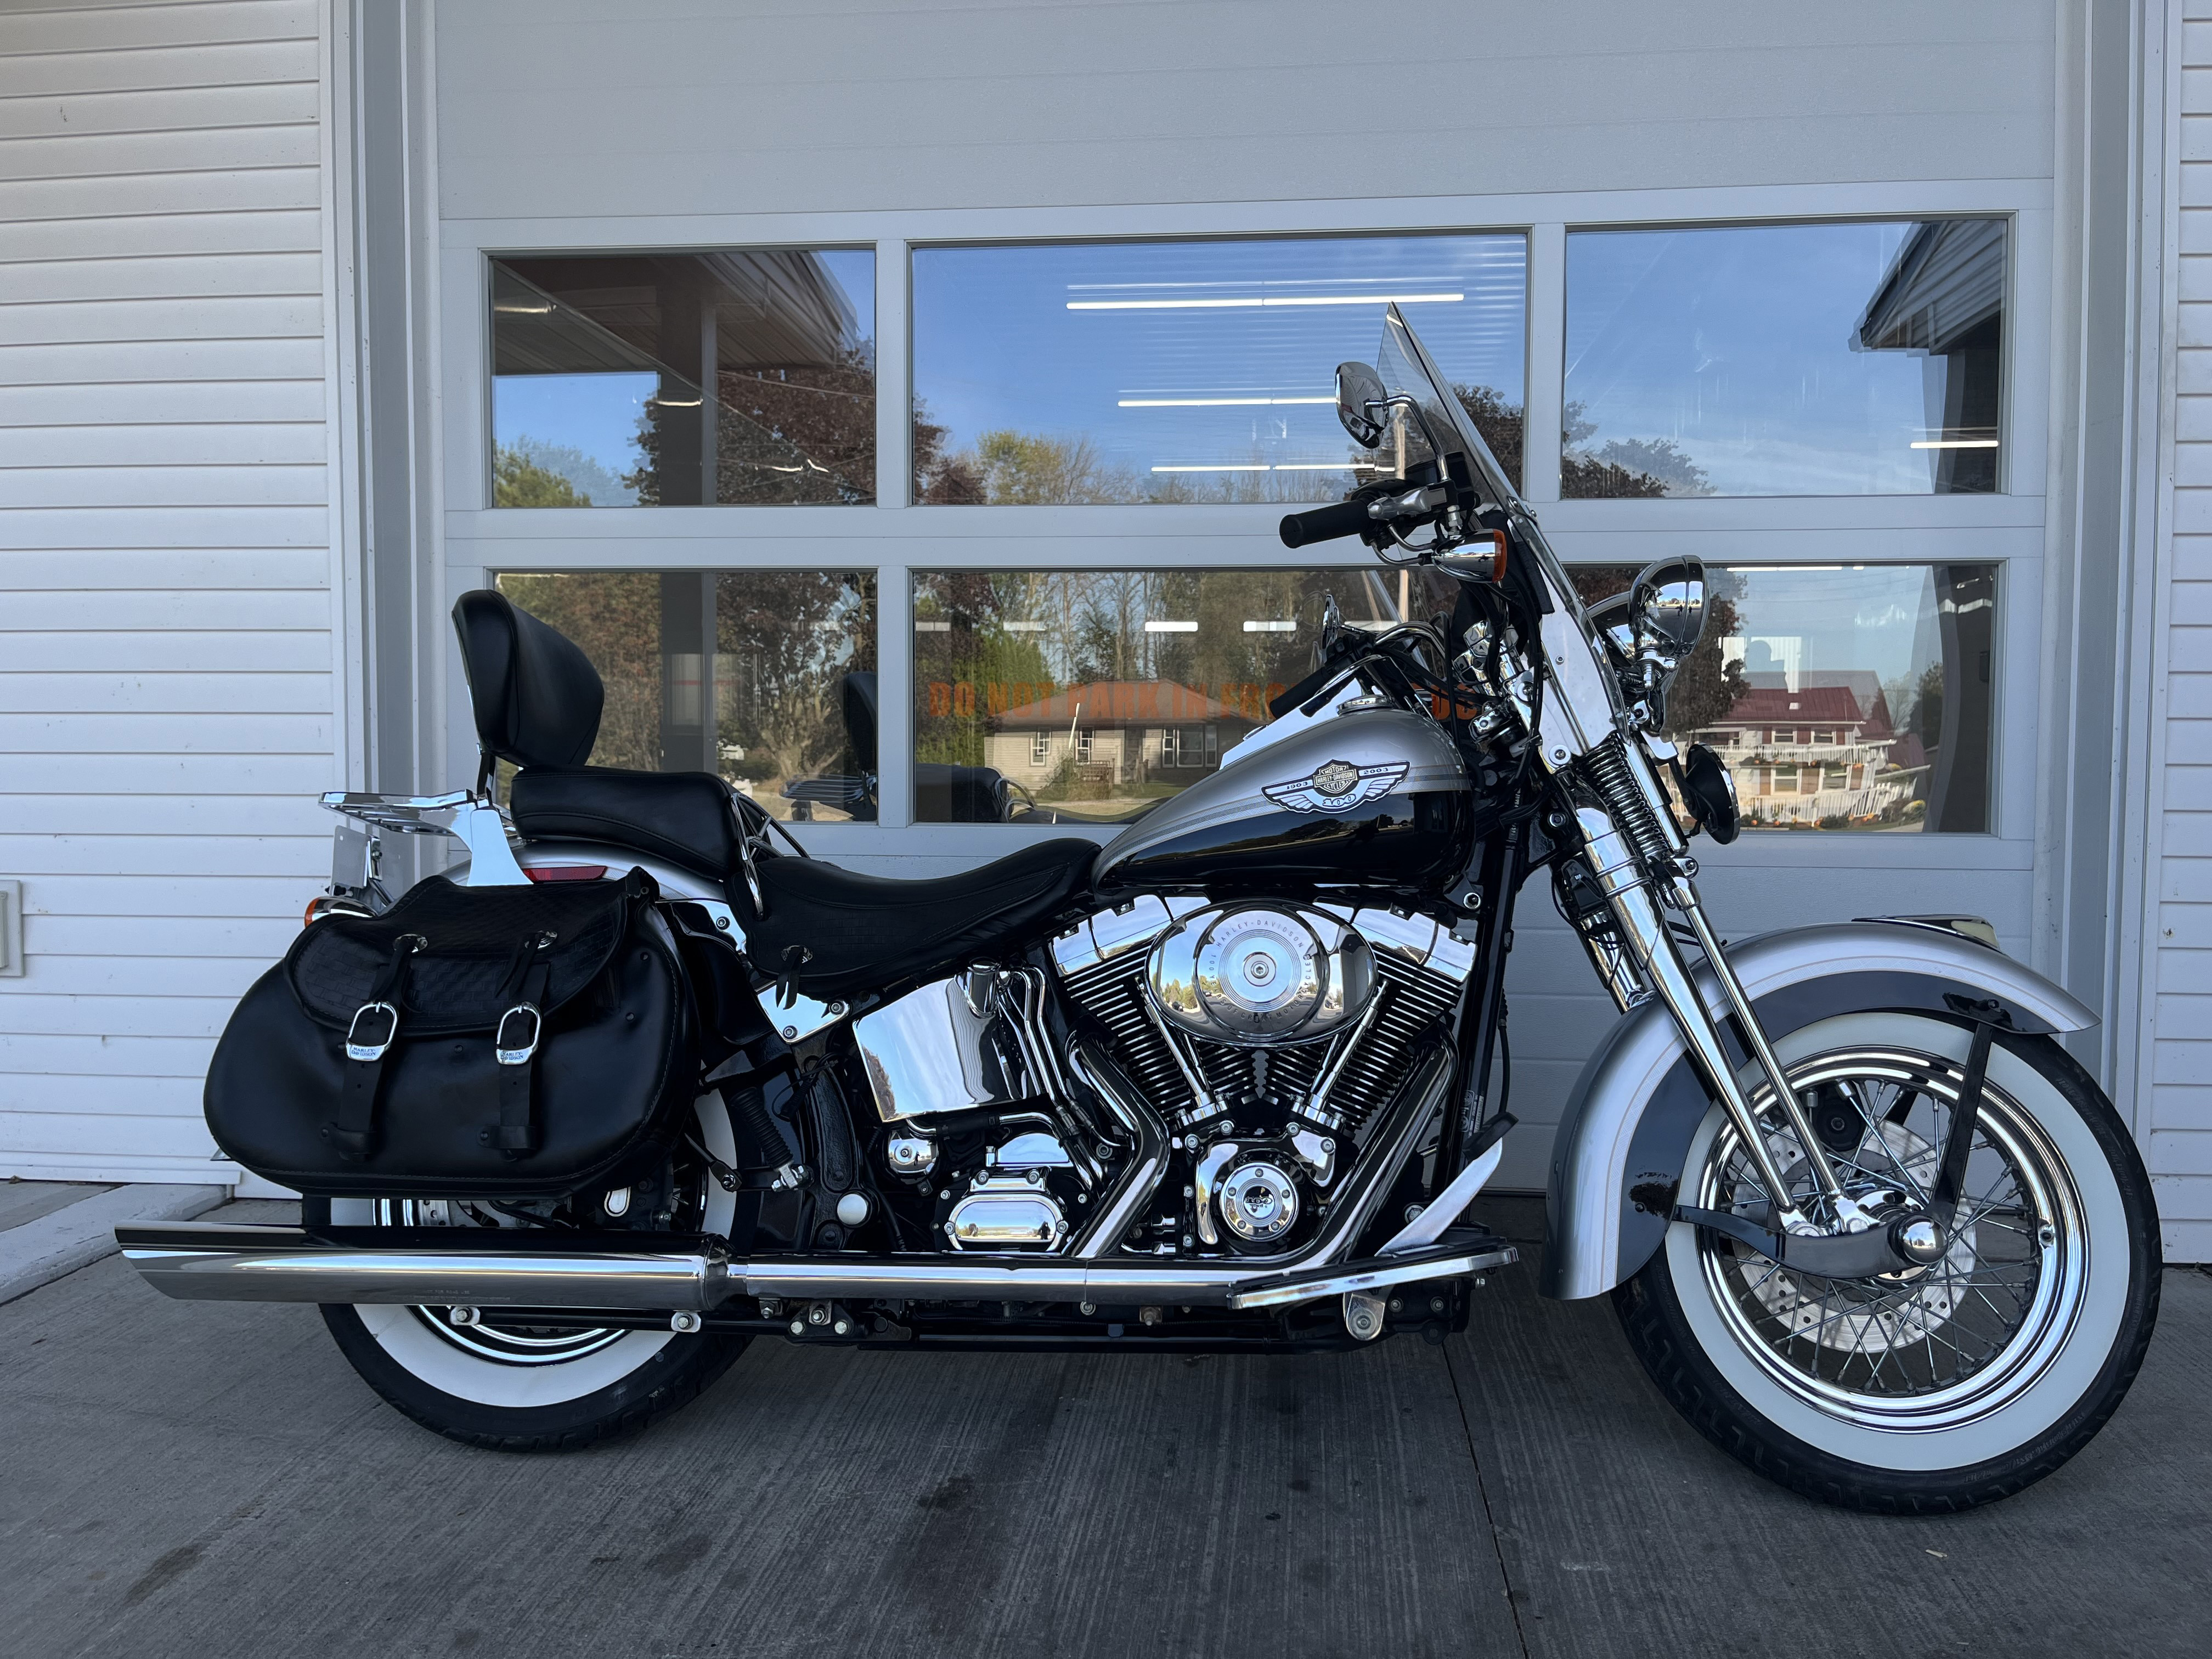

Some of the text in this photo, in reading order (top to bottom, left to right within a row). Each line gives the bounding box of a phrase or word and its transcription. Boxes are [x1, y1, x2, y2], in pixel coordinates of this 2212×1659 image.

[929, 681, 1297, 720] DO NOT PARK IN FRO
[1324, 766, 1344, 774] MOTOR
[1317, 771, 1353, 783] HARLEY-DAVIDSON
[1286, 781, 1308, 790] 1903
[1327, 780, 1346, 791] CYCLES
[1322, 793, 1357, 807] 100
[1216, 919, 1304, 948] HARLEY-DAVIDSON
